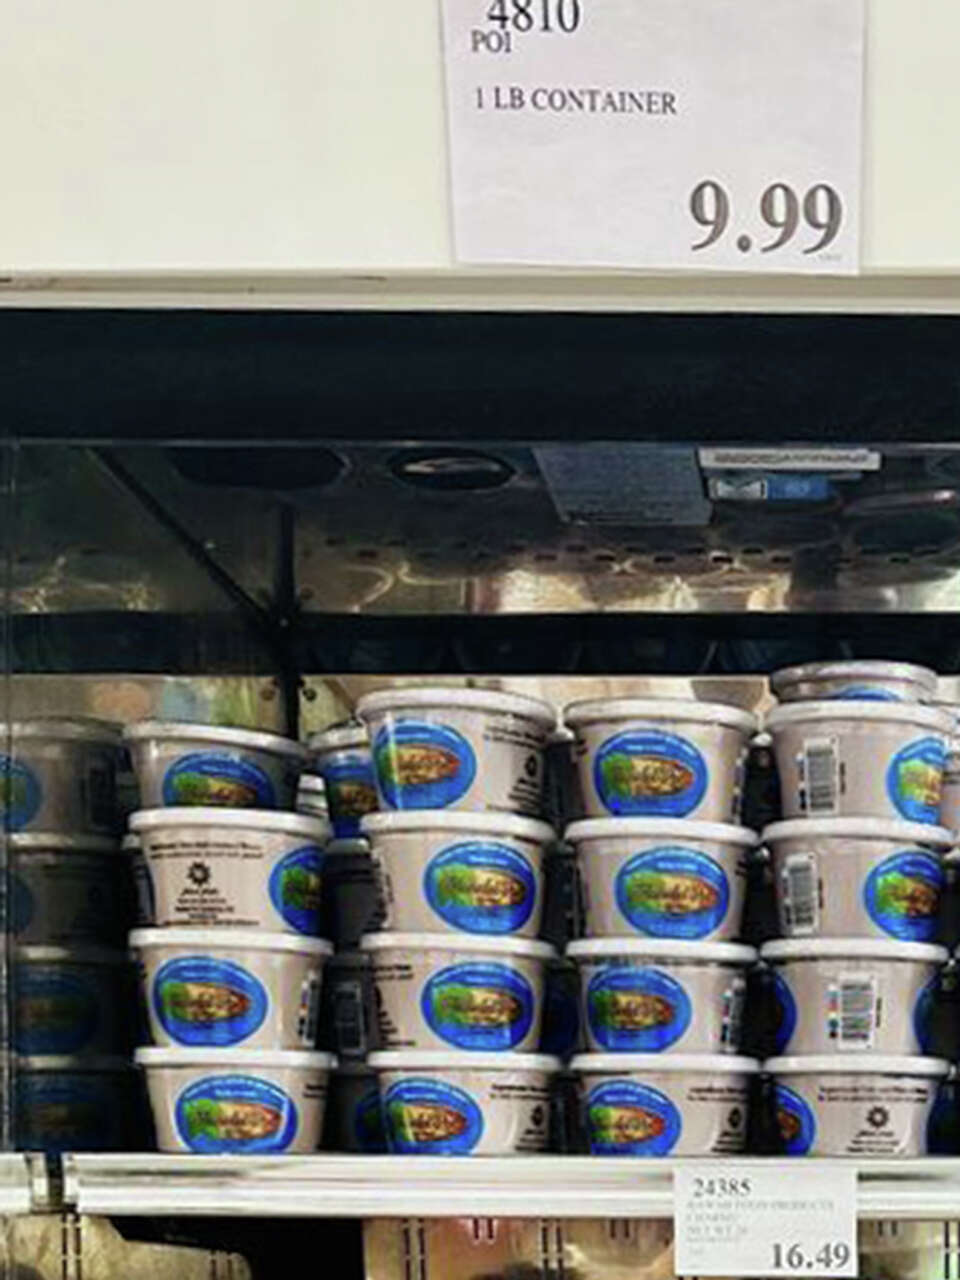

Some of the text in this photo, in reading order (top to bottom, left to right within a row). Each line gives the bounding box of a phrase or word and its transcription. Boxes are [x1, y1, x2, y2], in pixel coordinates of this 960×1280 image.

[487, 0, 580, 33] 4810
[471, 31, 512, 53] POI
[475, 87, 678, 115] 1 LB CONTAINER
[689, 180, 843, 255] 9.99
[693, 1177, 751, 1198] 24385
[773, 1242, 850, 1269] 16.49
